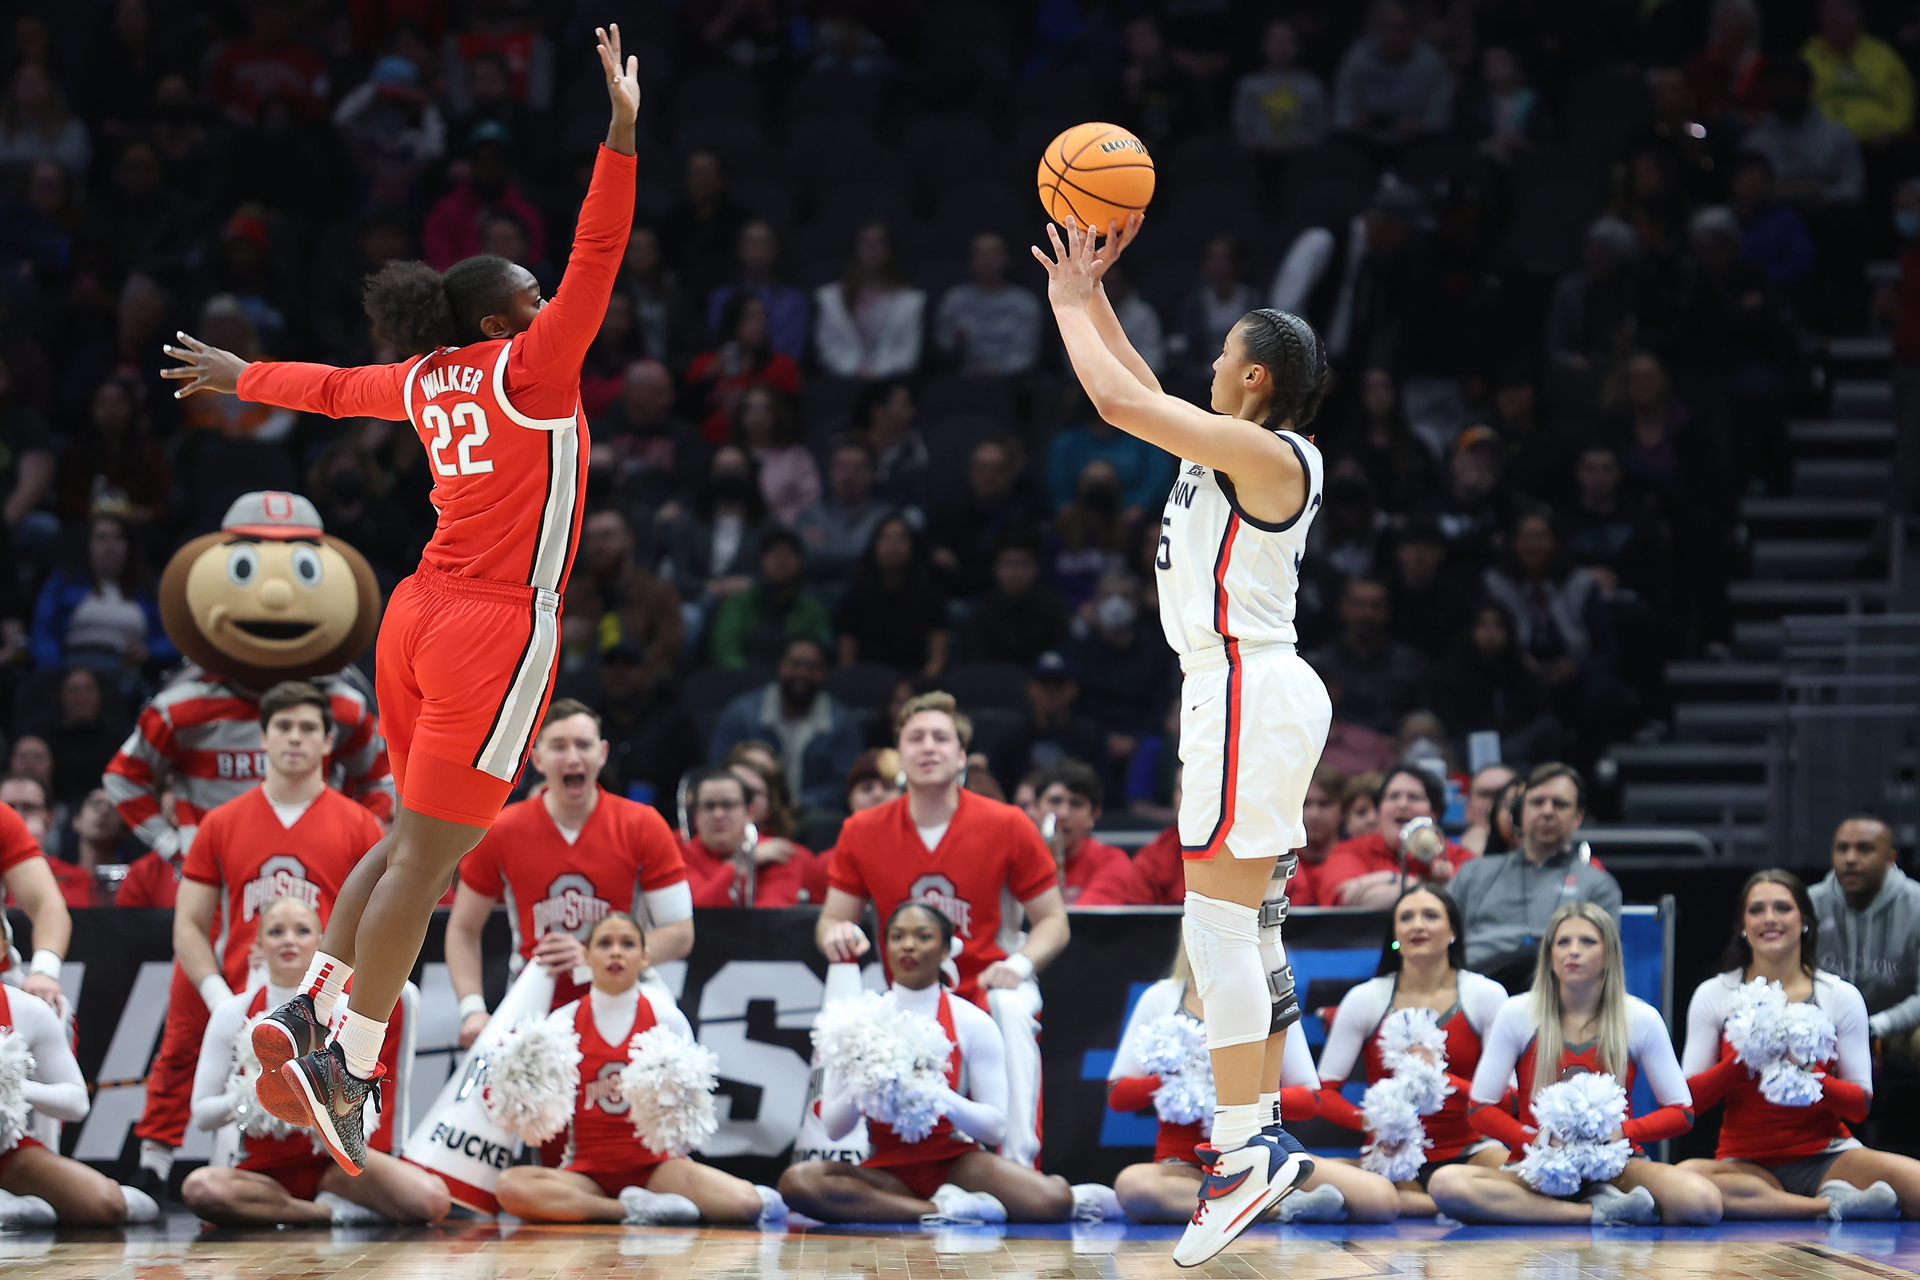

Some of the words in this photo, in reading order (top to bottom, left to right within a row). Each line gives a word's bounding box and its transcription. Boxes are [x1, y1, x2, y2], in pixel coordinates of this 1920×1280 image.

[1099, 139, 1150, 156] ilson
[420, 365, 484, 401] WALKER
[422, 401, 494, 476] 22
[1169, 480, 1198, 509] NN
